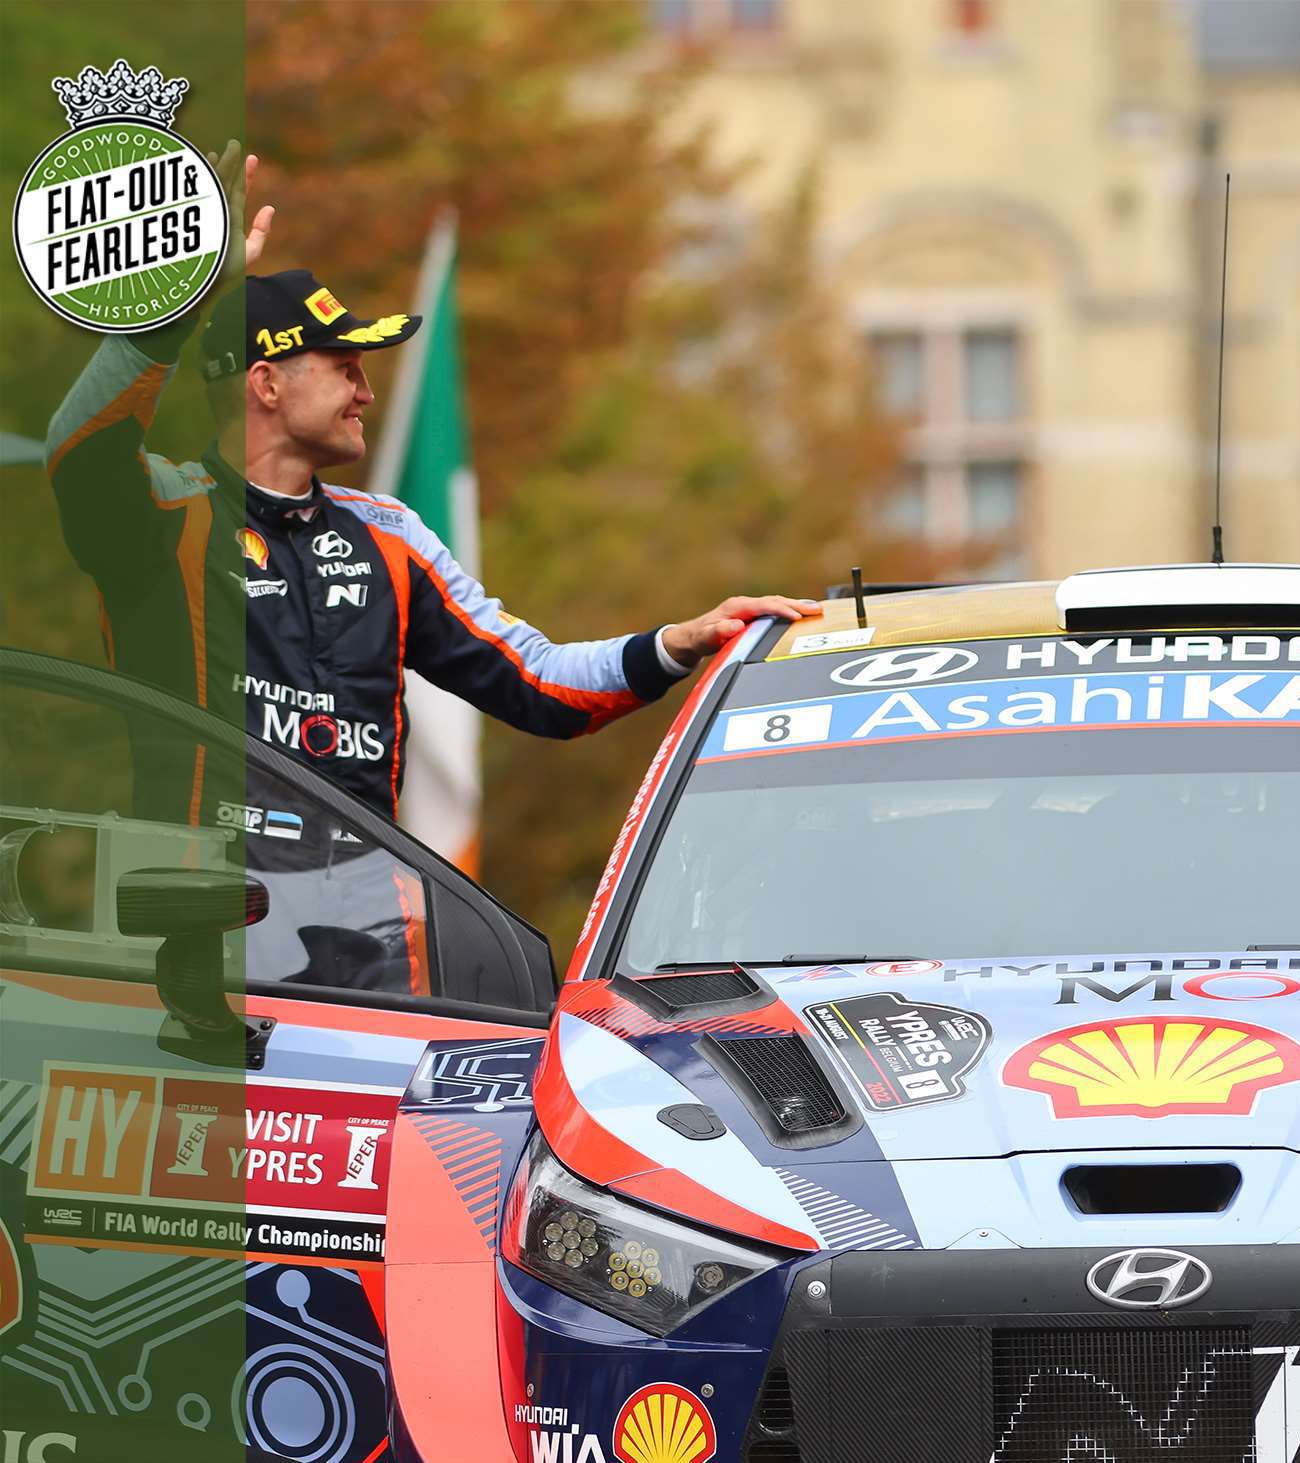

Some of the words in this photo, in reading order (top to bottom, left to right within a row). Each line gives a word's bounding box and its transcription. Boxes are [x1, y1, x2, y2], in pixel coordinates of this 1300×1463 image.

[256, 326, 303, 357] 1ST
[232, 674, 335, 712] HYUNDAI
[261, 703, 385, 761] MOBIS
[763, 714, 791, 742] 8
[217, 806, 263, 828] OMP
[859, 1018, 897, 1046] RALLY
[885, 1010, 953, 1068] YPRES
[906, 1079, 939, 1090] 8
[49, 1085, 142, 1178] HY
[245, 1109, 323, 1145] VISIT
[348, 1117, 361, 1125] CITY
[370, 1119, 390, 1127] PEACE
[175, 1122, 208, 1166] IEPER
[347, 1136, 376, 1180] IEPER
[228, 1146, 324, 1185] YPRES
[105, 1212, 136, 1233] FIA
[141, 1214, 198, 1238] World
[203, 1219, 252, 1245] Rally
[514, 1404, 568, 1426] HYUNDAI
